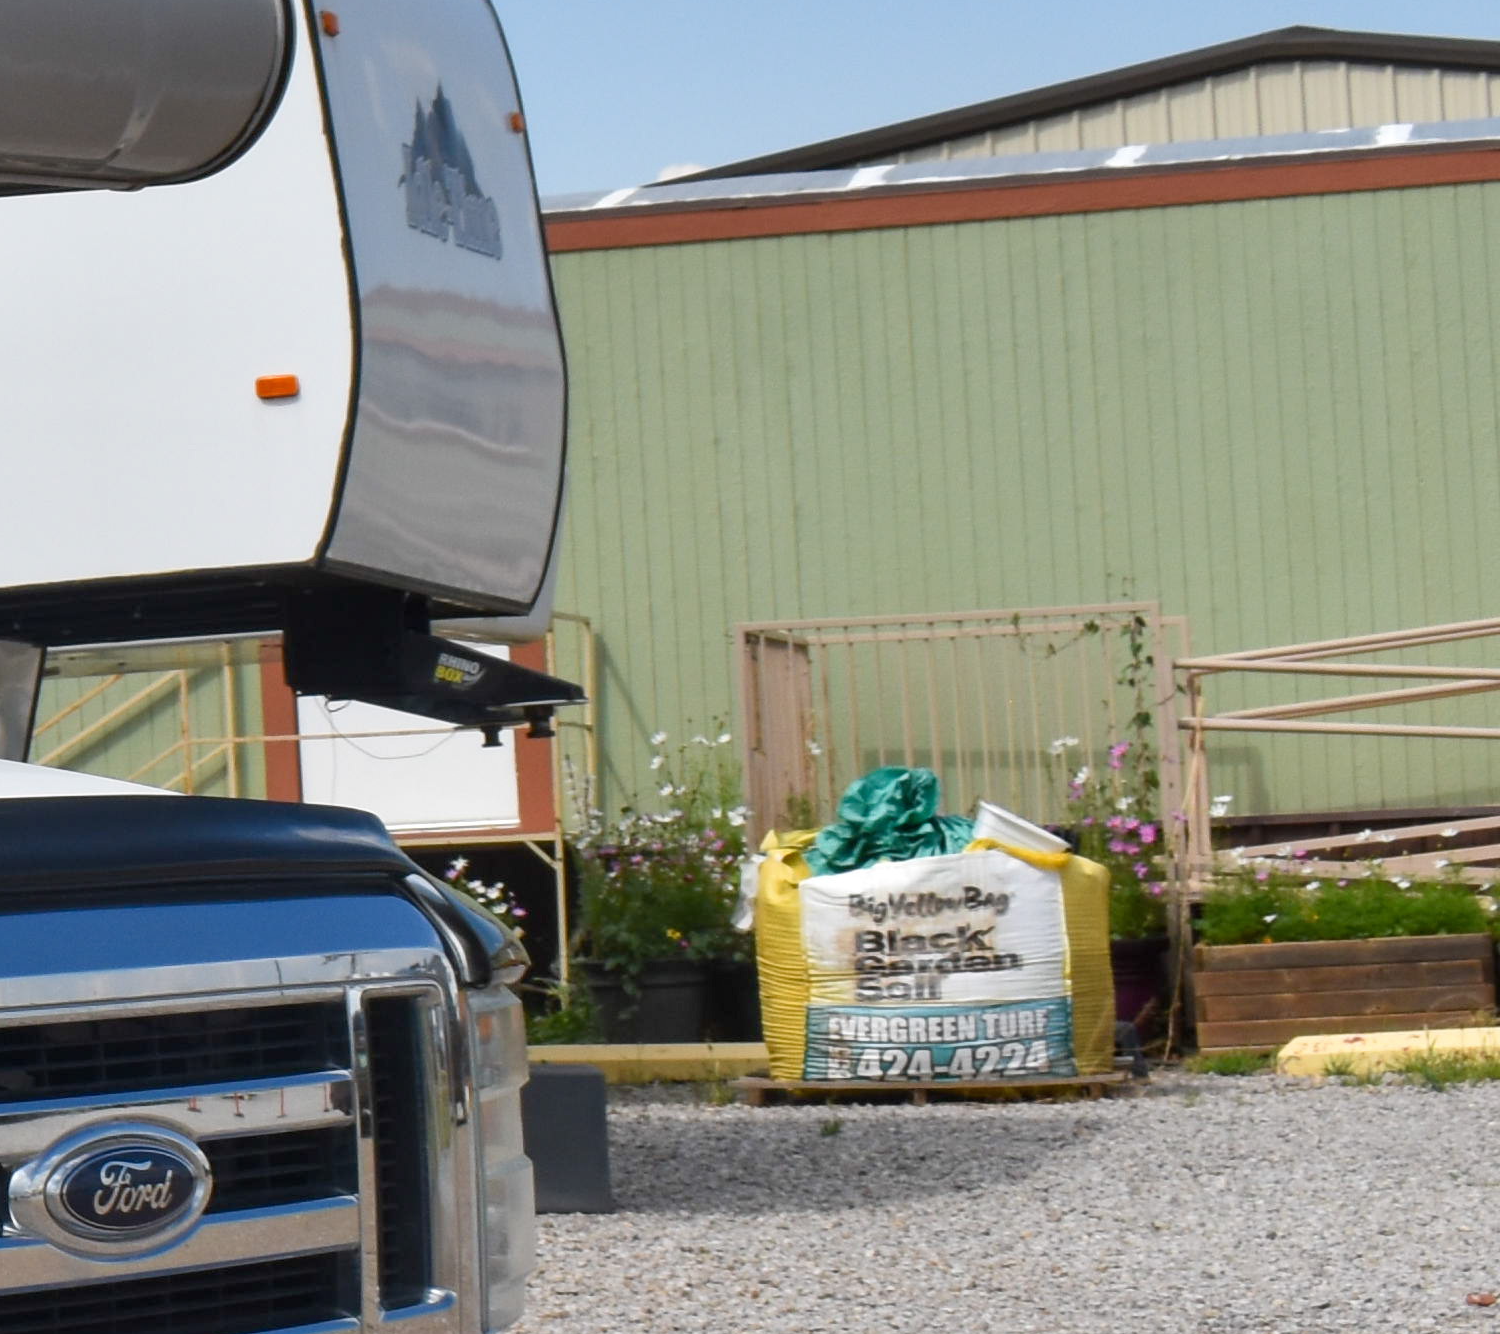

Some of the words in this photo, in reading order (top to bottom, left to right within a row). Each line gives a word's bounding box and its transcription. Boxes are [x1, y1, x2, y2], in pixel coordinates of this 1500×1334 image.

[854, 923, 995, 955] Black
[854, 951, 1021, 976] Garden
[854, 974, 942, 1002] Soil
[828, 1012, 977, 1043] EVERGREEN
[982, 1008, 1049, 1039] TURF
[856, 1040, 1051, 1080] 424-4224
[93, 1160, 173, 1216] Ford
